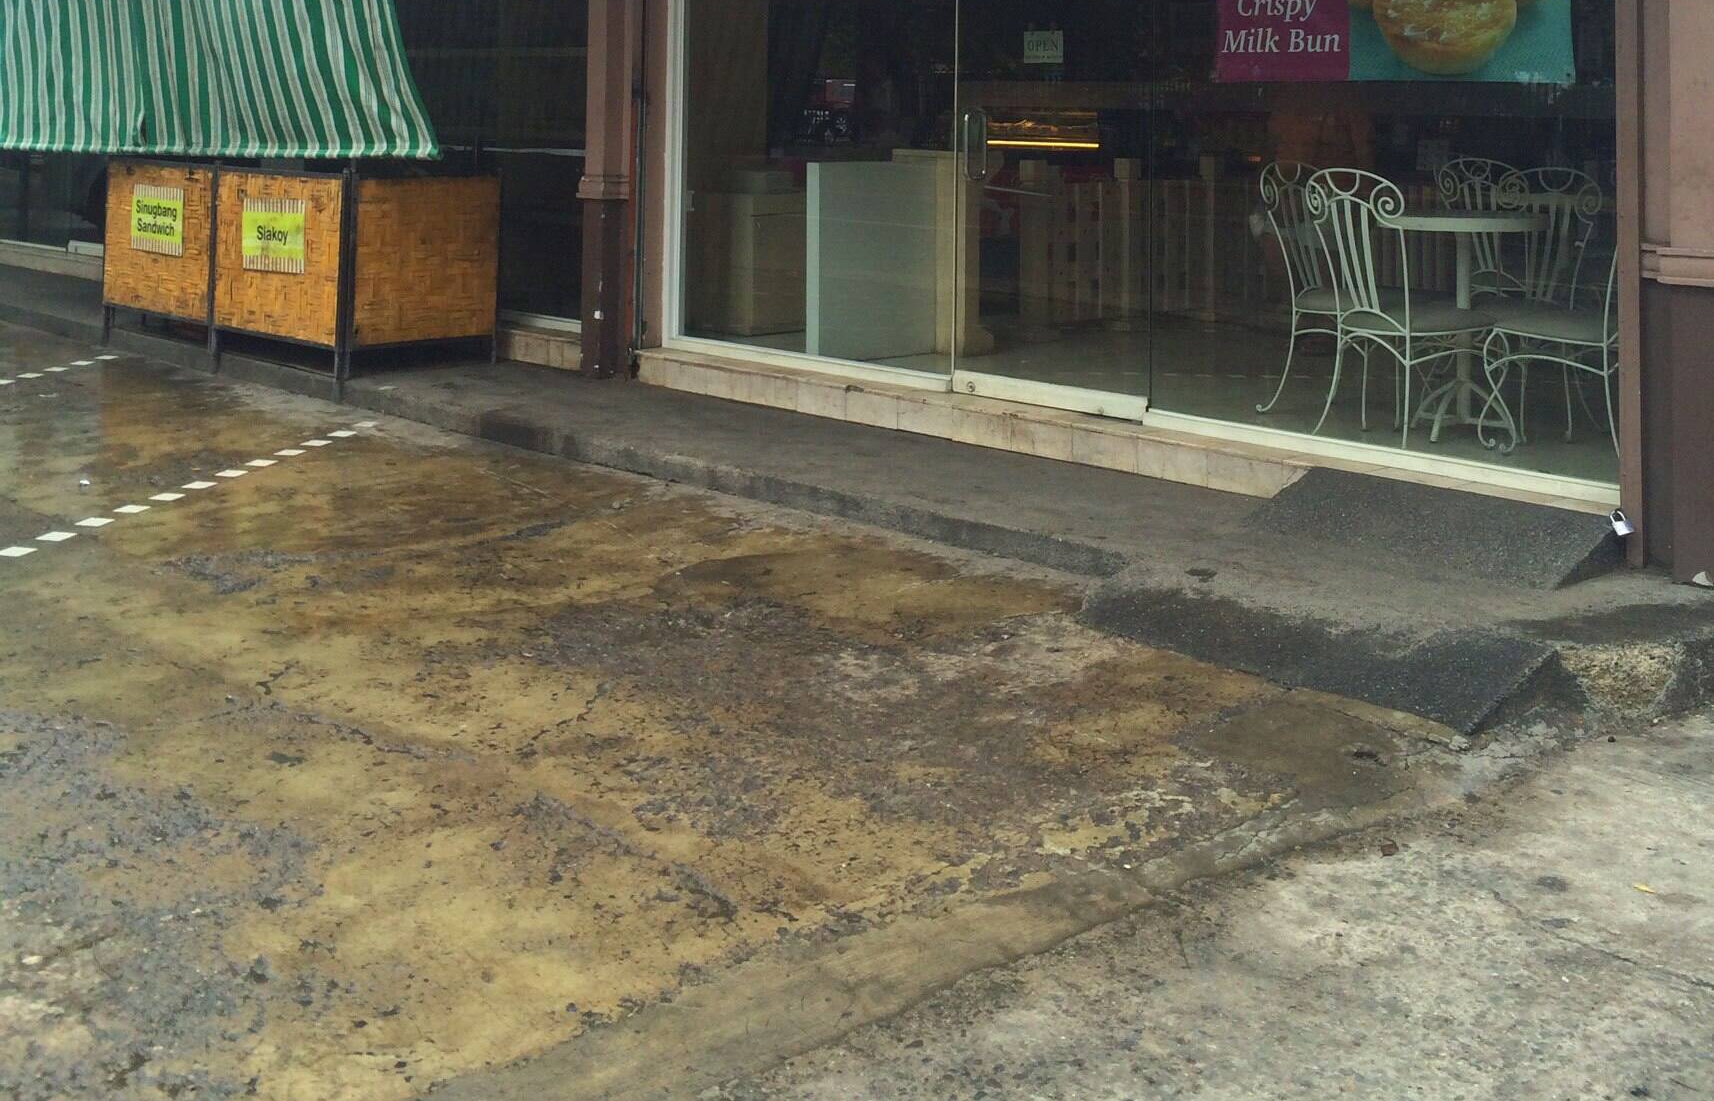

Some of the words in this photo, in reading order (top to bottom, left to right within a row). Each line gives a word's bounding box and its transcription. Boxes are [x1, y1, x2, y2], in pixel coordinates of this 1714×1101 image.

[1027, 40, 1059, 52] OPEN
[1221, 28, 1280, 53] Milk
[1287, 29, 1341, 53] Bun
[136, 200, 177, 222] Sinugbang
[136, 218, 175, 237] Sandwich
